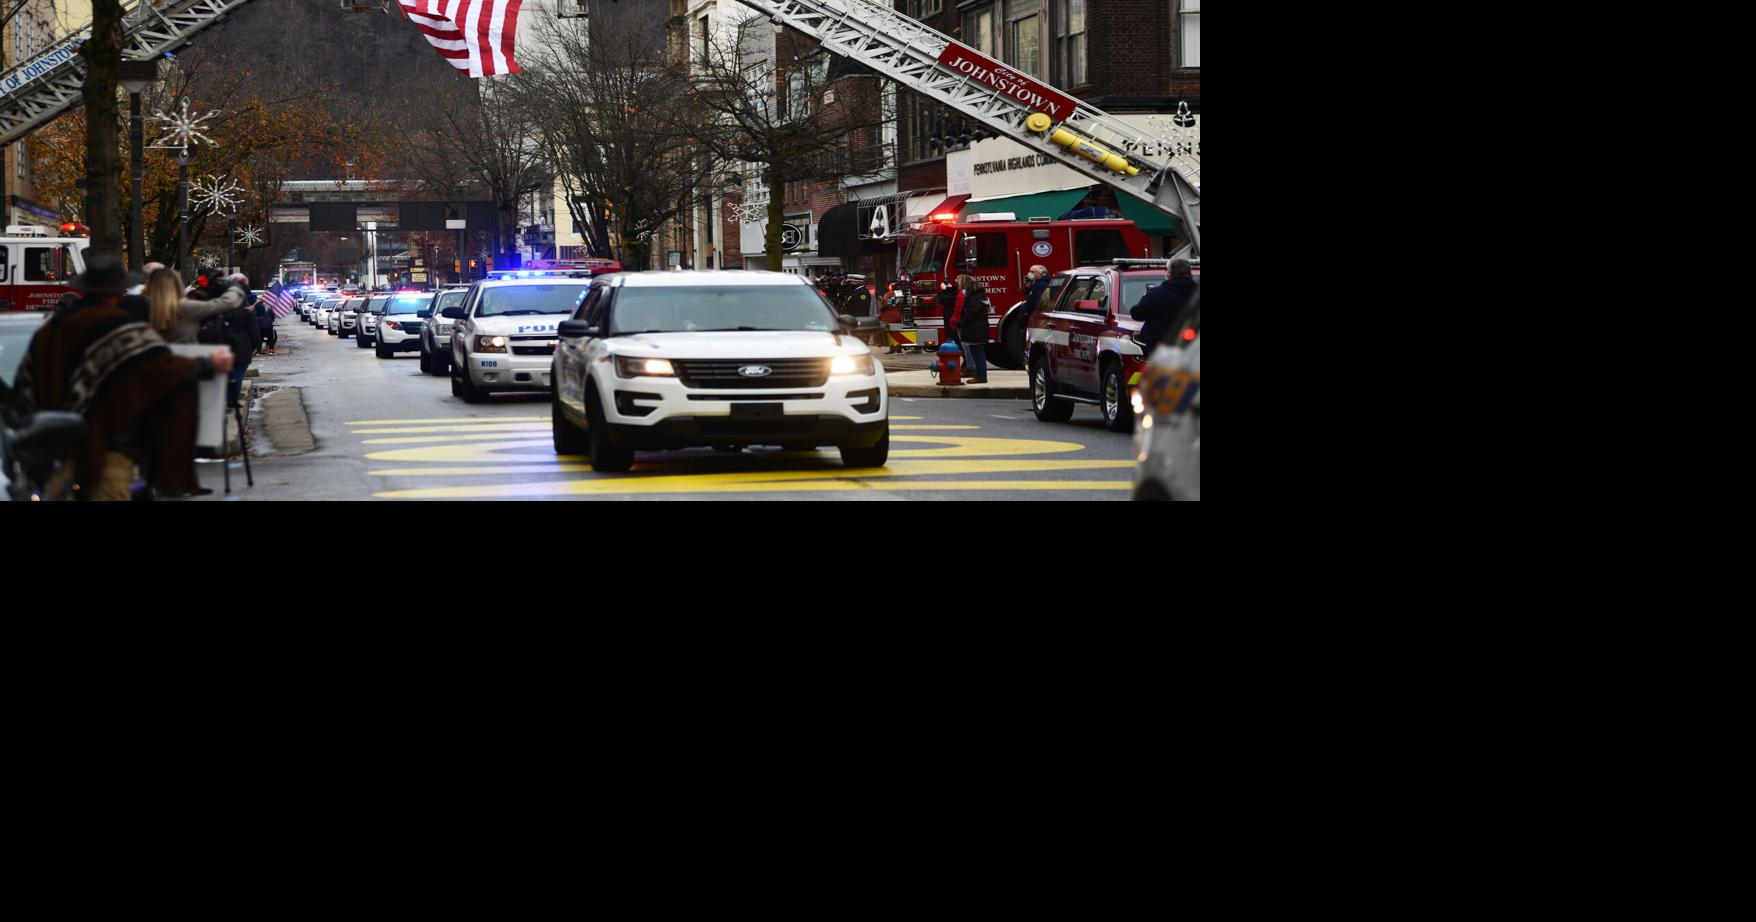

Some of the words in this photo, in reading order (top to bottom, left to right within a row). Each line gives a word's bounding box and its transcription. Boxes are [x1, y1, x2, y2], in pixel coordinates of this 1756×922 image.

[994, 67, 1017, 80] City
[5, 74, 22, 89] OF
[948, 57, 1061, 116] JOHNSTOWN
[481, 360, 498, 368] N106
